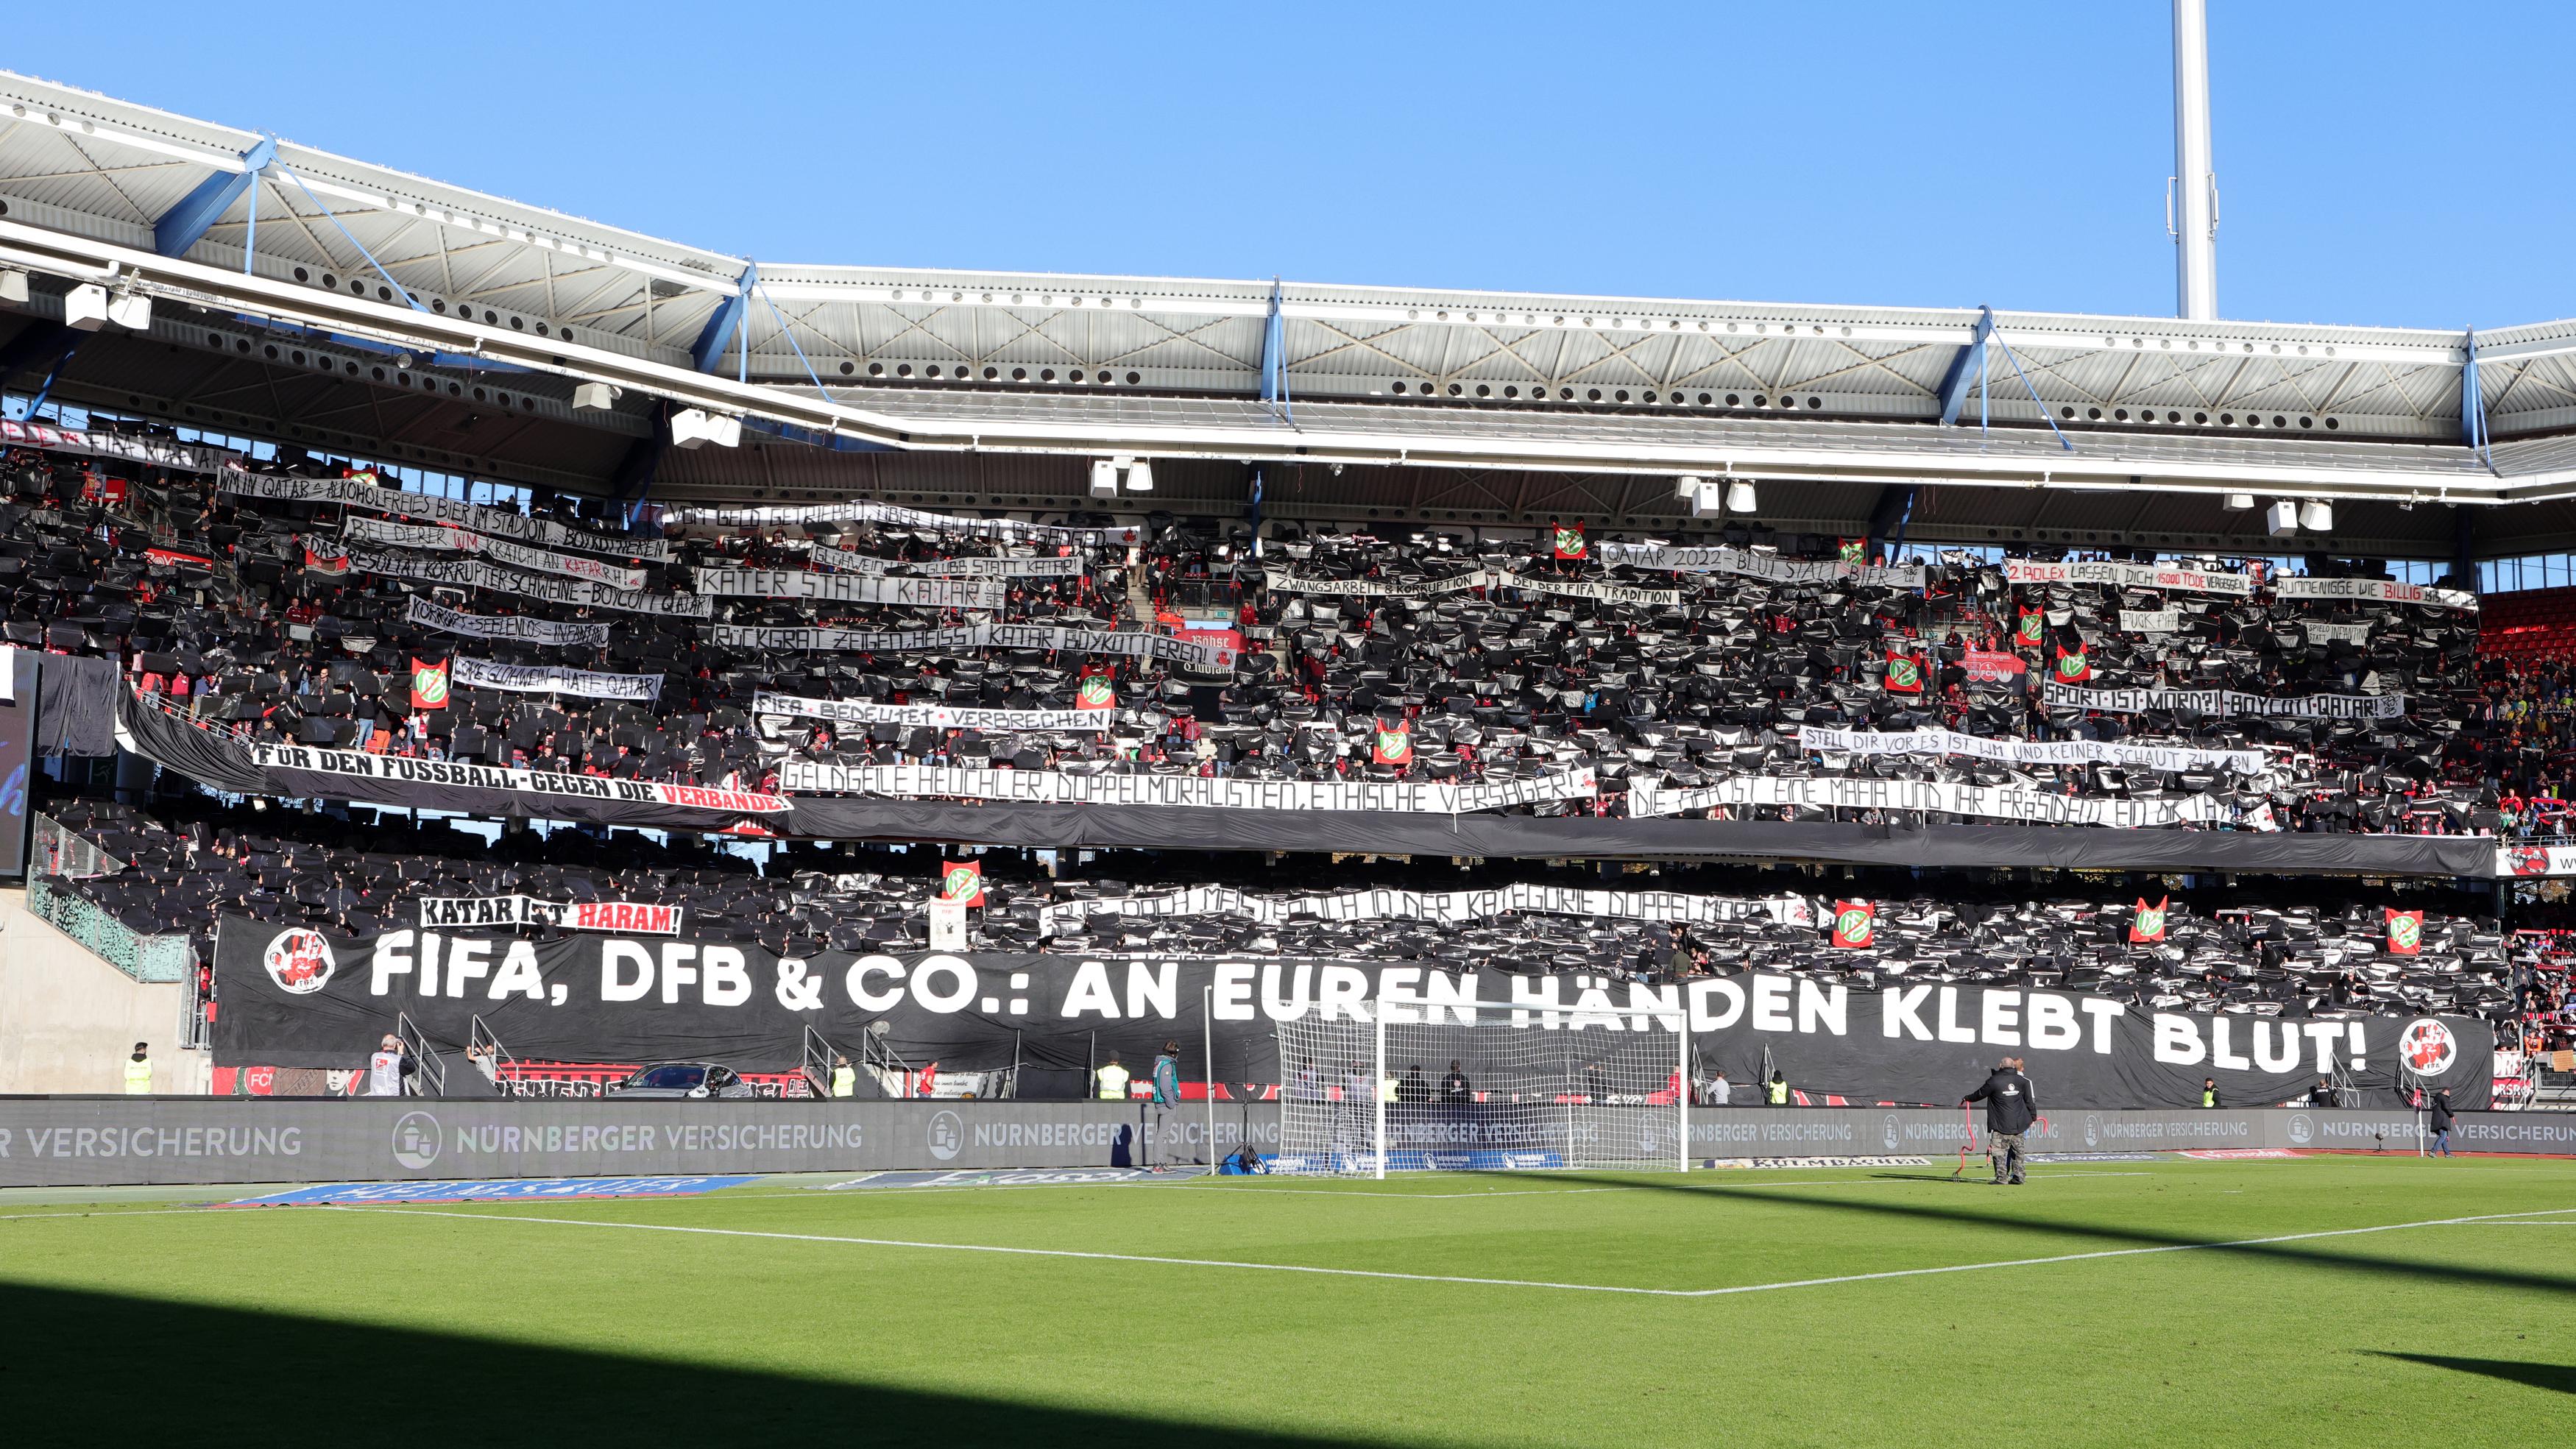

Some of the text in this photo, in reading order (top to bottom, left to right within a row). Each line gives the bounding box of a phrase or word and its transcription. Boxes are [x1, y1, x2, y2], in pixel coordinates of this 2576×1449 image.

[85, 431, 134, 456] FIFA
[243, 473, 257, 495] IN
[262, 478, 310, 499] QATAR
[436, 497, 470, 524] BIER
[475, 506, 488, 530] IM
[669, 502, 706, 526] VOM
[717, 510, 760, 528] GELD
[352, 518, 384, 537] BEI
[394, 526, 447, 546] DERER
[453, 532, 478, 551] WM
[543, 554, 560, 570] AN
[310, 536, 341, 559] DAS
[423, 561, 507, 591] KORRUPTER
[509, 573, 579, 603] SCHWEINE
[925, 560, 968, 575] GLUBB
[972, 559, 1019, 575] STATT
[1027, 559, 1078, 575] KATAR!
[1606, 544, 1666, 568] QATAR
[1674, 549, 1722, 567] 2022
[1736, 553, 1778, 575] BLUT
[1785, 559, 1841, 581] STATT
[1848, 564, 1886, 585] BIER
[2009, 564, 2246, 591] 2 ROLEX LASSEN DICH 15000 TODE VERGESSEN
[701, 568, 980, 607] KATER STATT KATAR
[1275, 573, 1473, 595] ZWANGSARBEIT & KORRUPTION
[1512, 575, 1672, 604] BEI DER FIFA TRADITION
[2276, 578, 2354, 595] RUMMENIGGE
[2358, 581, 2379, 598] WIE
[2382, 582, 2422, 601] BILLIG
[2121, 612, 2179, 629] FUCK FIFA
[714, 626, 821, 650] RÜCKGRAT
[913, 626, 977, 648] HEISST
[988, 626, 1055, 648] KATAR
[1064, 630, 1208, 664] BOYKOTTIEREN!
[1191, 634, 1230, 648] Böhse
[2308, 633, 2327, 642] STATT
[561, 674, 601, 694] HATE
[606, 676, 659, 697] QATAR!
[2044, 681, 2102, 707] SPORT
[2108, 690, 2141, 709] IST
[2317, 695, 2379, 718] QATAR!
[756, 694, 1105, 729] FIFA BEDEUTET VERBRECHEN
[1805, 728, 1845, 748] STELL
[1853, 735, 1880, 750] DIR
[1883, 735, 1917, 751] VOR
[1920, 734, 1939, 749] ES
[1947, 733, 1974, 750] IST
[1979, 740, 2004, 757] WM
[2013, 744, 2043, 760] UND
[2049, 743, 2107, 760] KEINER
[2114, 748, 2181, 768] SCHAUT
[258, 744, 312, 769] FÜR
[316, 750, 374, 776] DEN
[380, 757, 518, 790] FUSSBALL
[531, 772, 611, 798] GEGEN
[615, 780, 657, 802] DIE
[660, 784, 788, 811] VERBÄNDE!
[782, 762, 909, 793] GELDGEILE
[1311, 781, 1426, 812] ETHISCHE
[1439, 771, 1574, 812] VERSAGER!
[1635, 789, 1666, 817] DIE
[1678, 784, 1723, 810] FIFA
[1731, 776, 1761, 804] IST
[1774, 777, 1817, 804] EINE
[1830, 778, 1889, 807] MAFIA
[1900, 781, 1942, 810] UND
[1954, 784, 1985, 815] IHR
[422, 896, 514, 924] KATAR
[576, 902, 681, 933] HARAM!
[1121, 894, 1189, 917] DOCH
[1402, 891, 1452, 921] DER
[1467, 883, 1595, 919] KATEGORIE
[370, 929, 2366, 1074] FIFA, DFB & CO.: AN EUREN HÄNDEN KLEBT BLUT!
[26, 1127, 302, 1158] VERSICHERUNG
[456, 1122, 863, 1154] NÜRNBERGER VERSICHERUNG
[974, 1120, 1279, 1147] NÜRNBERGER VESICHERUNG
[1668, 1123, 1852, 1142] NRNBERGER VERSICHERUNG
[2102, 1121, 2248, 1138] NÜRNBERGER VERSICHERUNG
